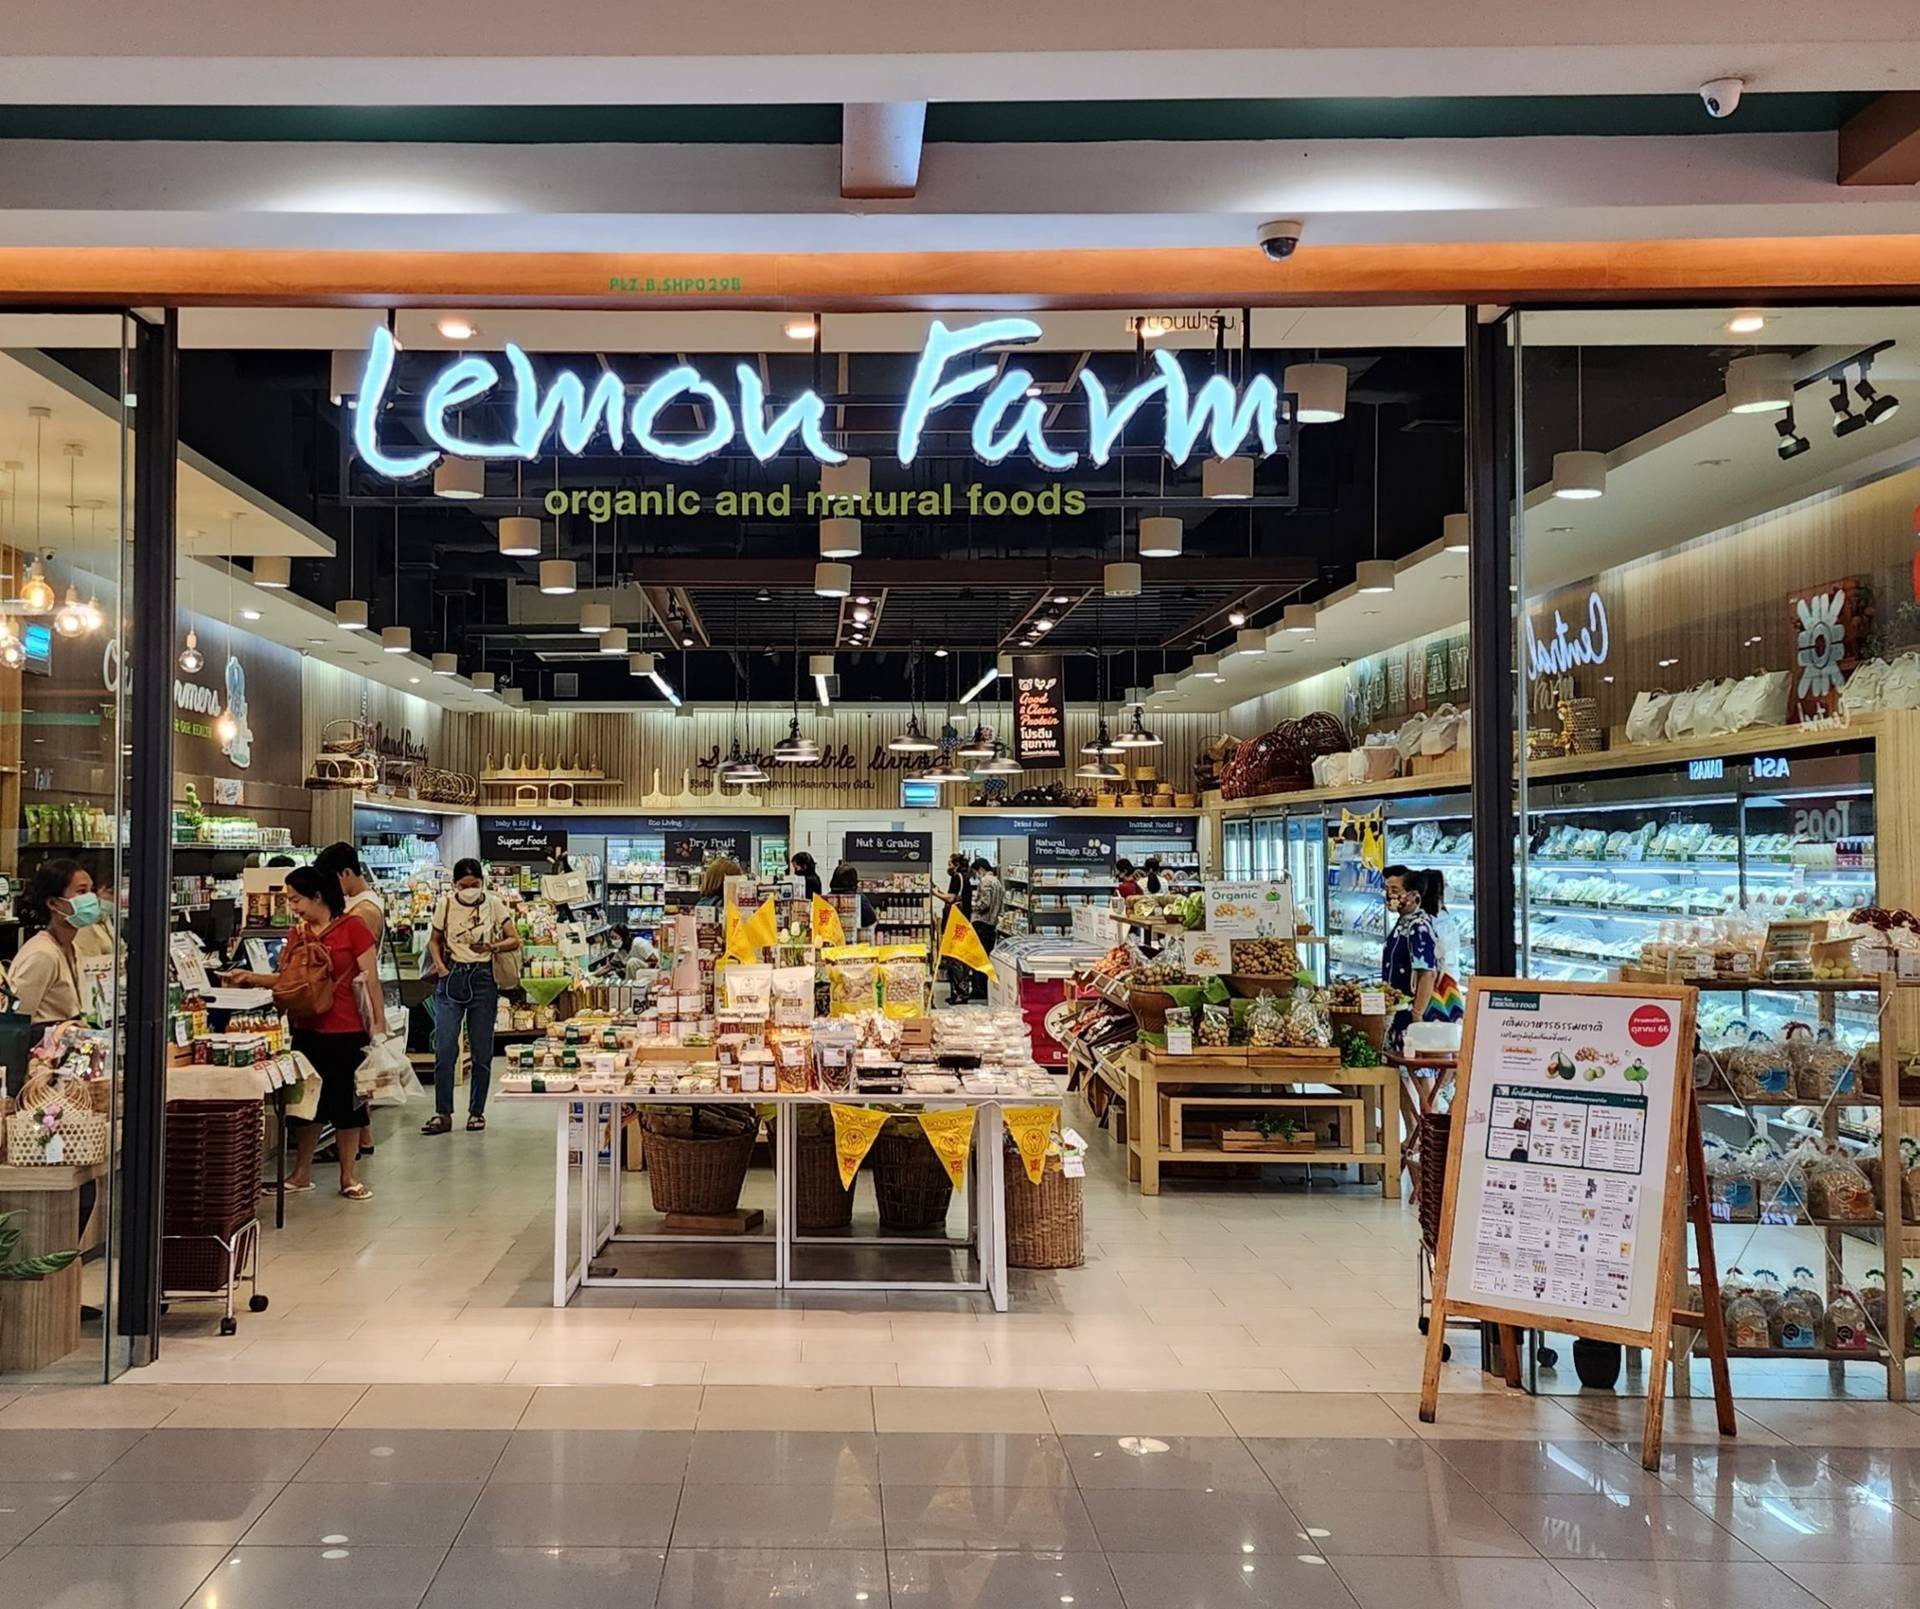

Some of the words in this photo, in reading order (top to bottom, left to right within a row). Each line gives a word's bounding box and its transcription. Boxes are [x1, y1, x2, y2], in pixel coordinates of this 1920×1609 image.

[609, 277, 742, 291] PLZ.B.SHP029B
[1130, 310, 1235, 330] เมอนฟาร์ม
[354, 325, 849, 478] Lemon
[899, 318, 1278, 471] Farm
[544, 484, 701, 522] organic
[715, 484, 791, 516] and
[807, 484, 951, 516] natural
[967, 483, 1087, 516] foods
[1020, 692, 1049, 705] Good
[1027, 704, 1057, 715] Clean
[1020, 714, 1060, 726] Protein
[1021, 727, 1052, 739] โปรตีน
[661, 819, 683, 828] Living
[497, 835, 525, 849] Super
[527, 835, 548, 845] Food
[689, 837, 708, 849] Dry
[710, 837, 736, 848] Fruit
[856, 838, 874, 848] Nut
[876, 838, 884, 848] &
[886, 838, 921, 849] Grains
[1035, 838, 1066, 848] Natural
[1081, 847, 1098, 857] Egg
[1212, 891, 1258, 902] Organic
